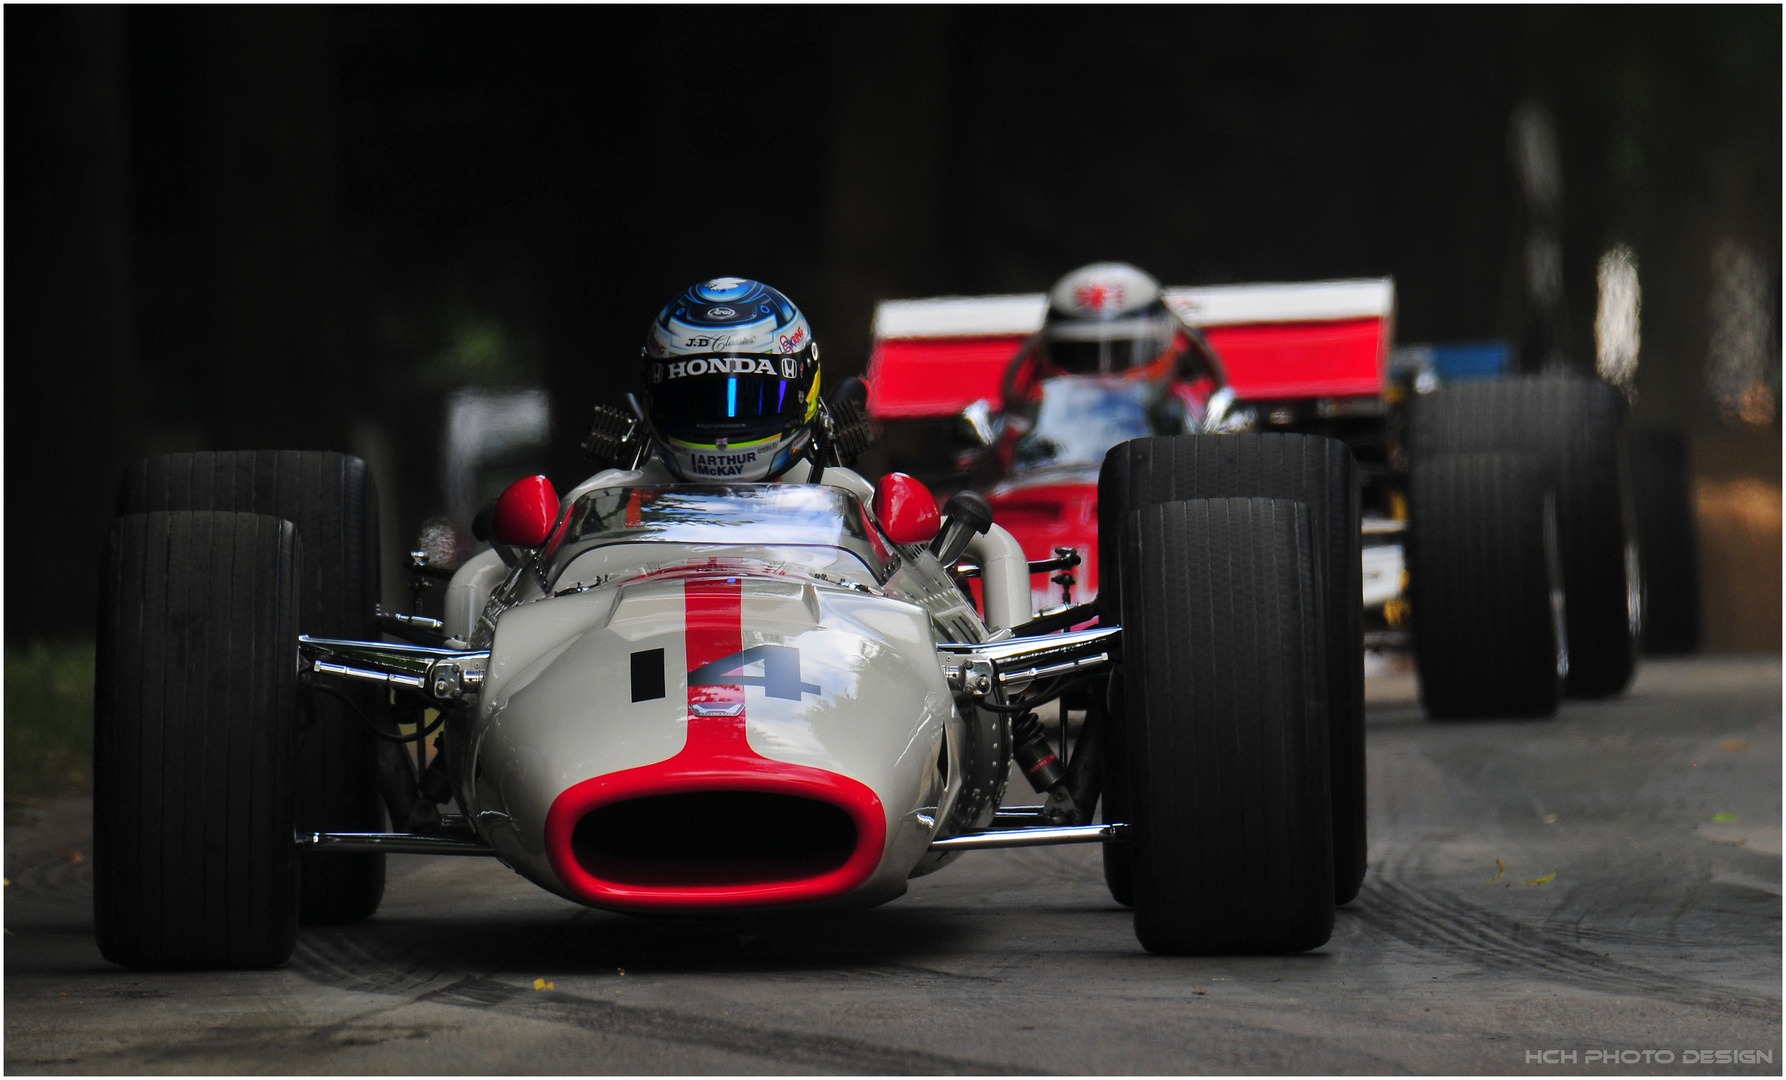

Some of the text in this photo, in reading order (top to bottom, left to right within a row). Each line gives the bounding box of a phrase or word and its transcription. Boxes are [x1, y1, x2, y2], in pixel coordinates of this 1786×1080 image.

[667, 357, 778, 379] HONDA
[697, 452, 757, 466] ARTHUR
[697, 465, 745, 476] McKAY
